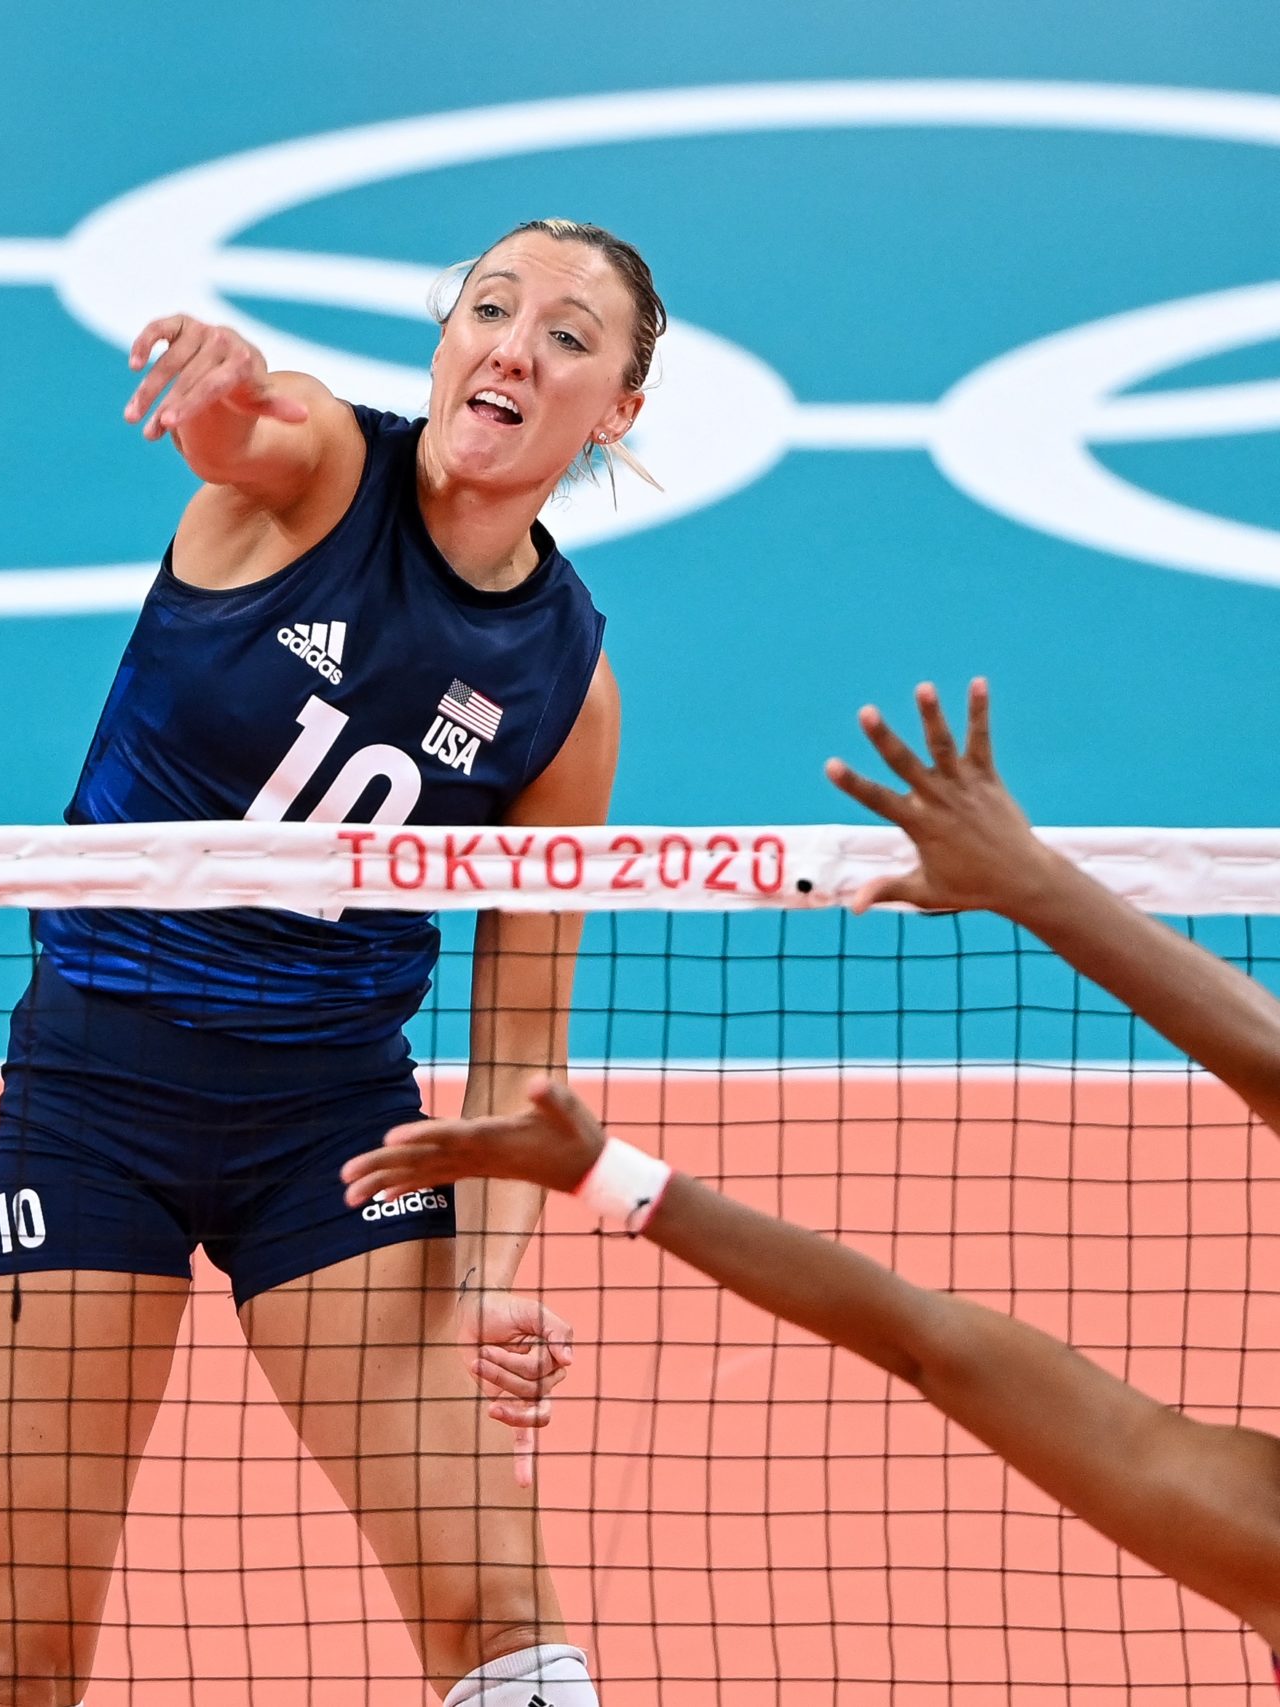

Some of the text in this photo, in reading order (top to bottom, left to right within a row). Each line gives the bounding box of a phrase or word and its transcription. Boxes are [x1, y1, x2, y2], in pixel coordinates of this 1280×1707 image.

[276, 626, 344, 685] adidas
[421, 715, 481, 776] USA
[337, 831, 785, 894] TOKYO 2020
[361, 1192, 448, 1221] adidas
